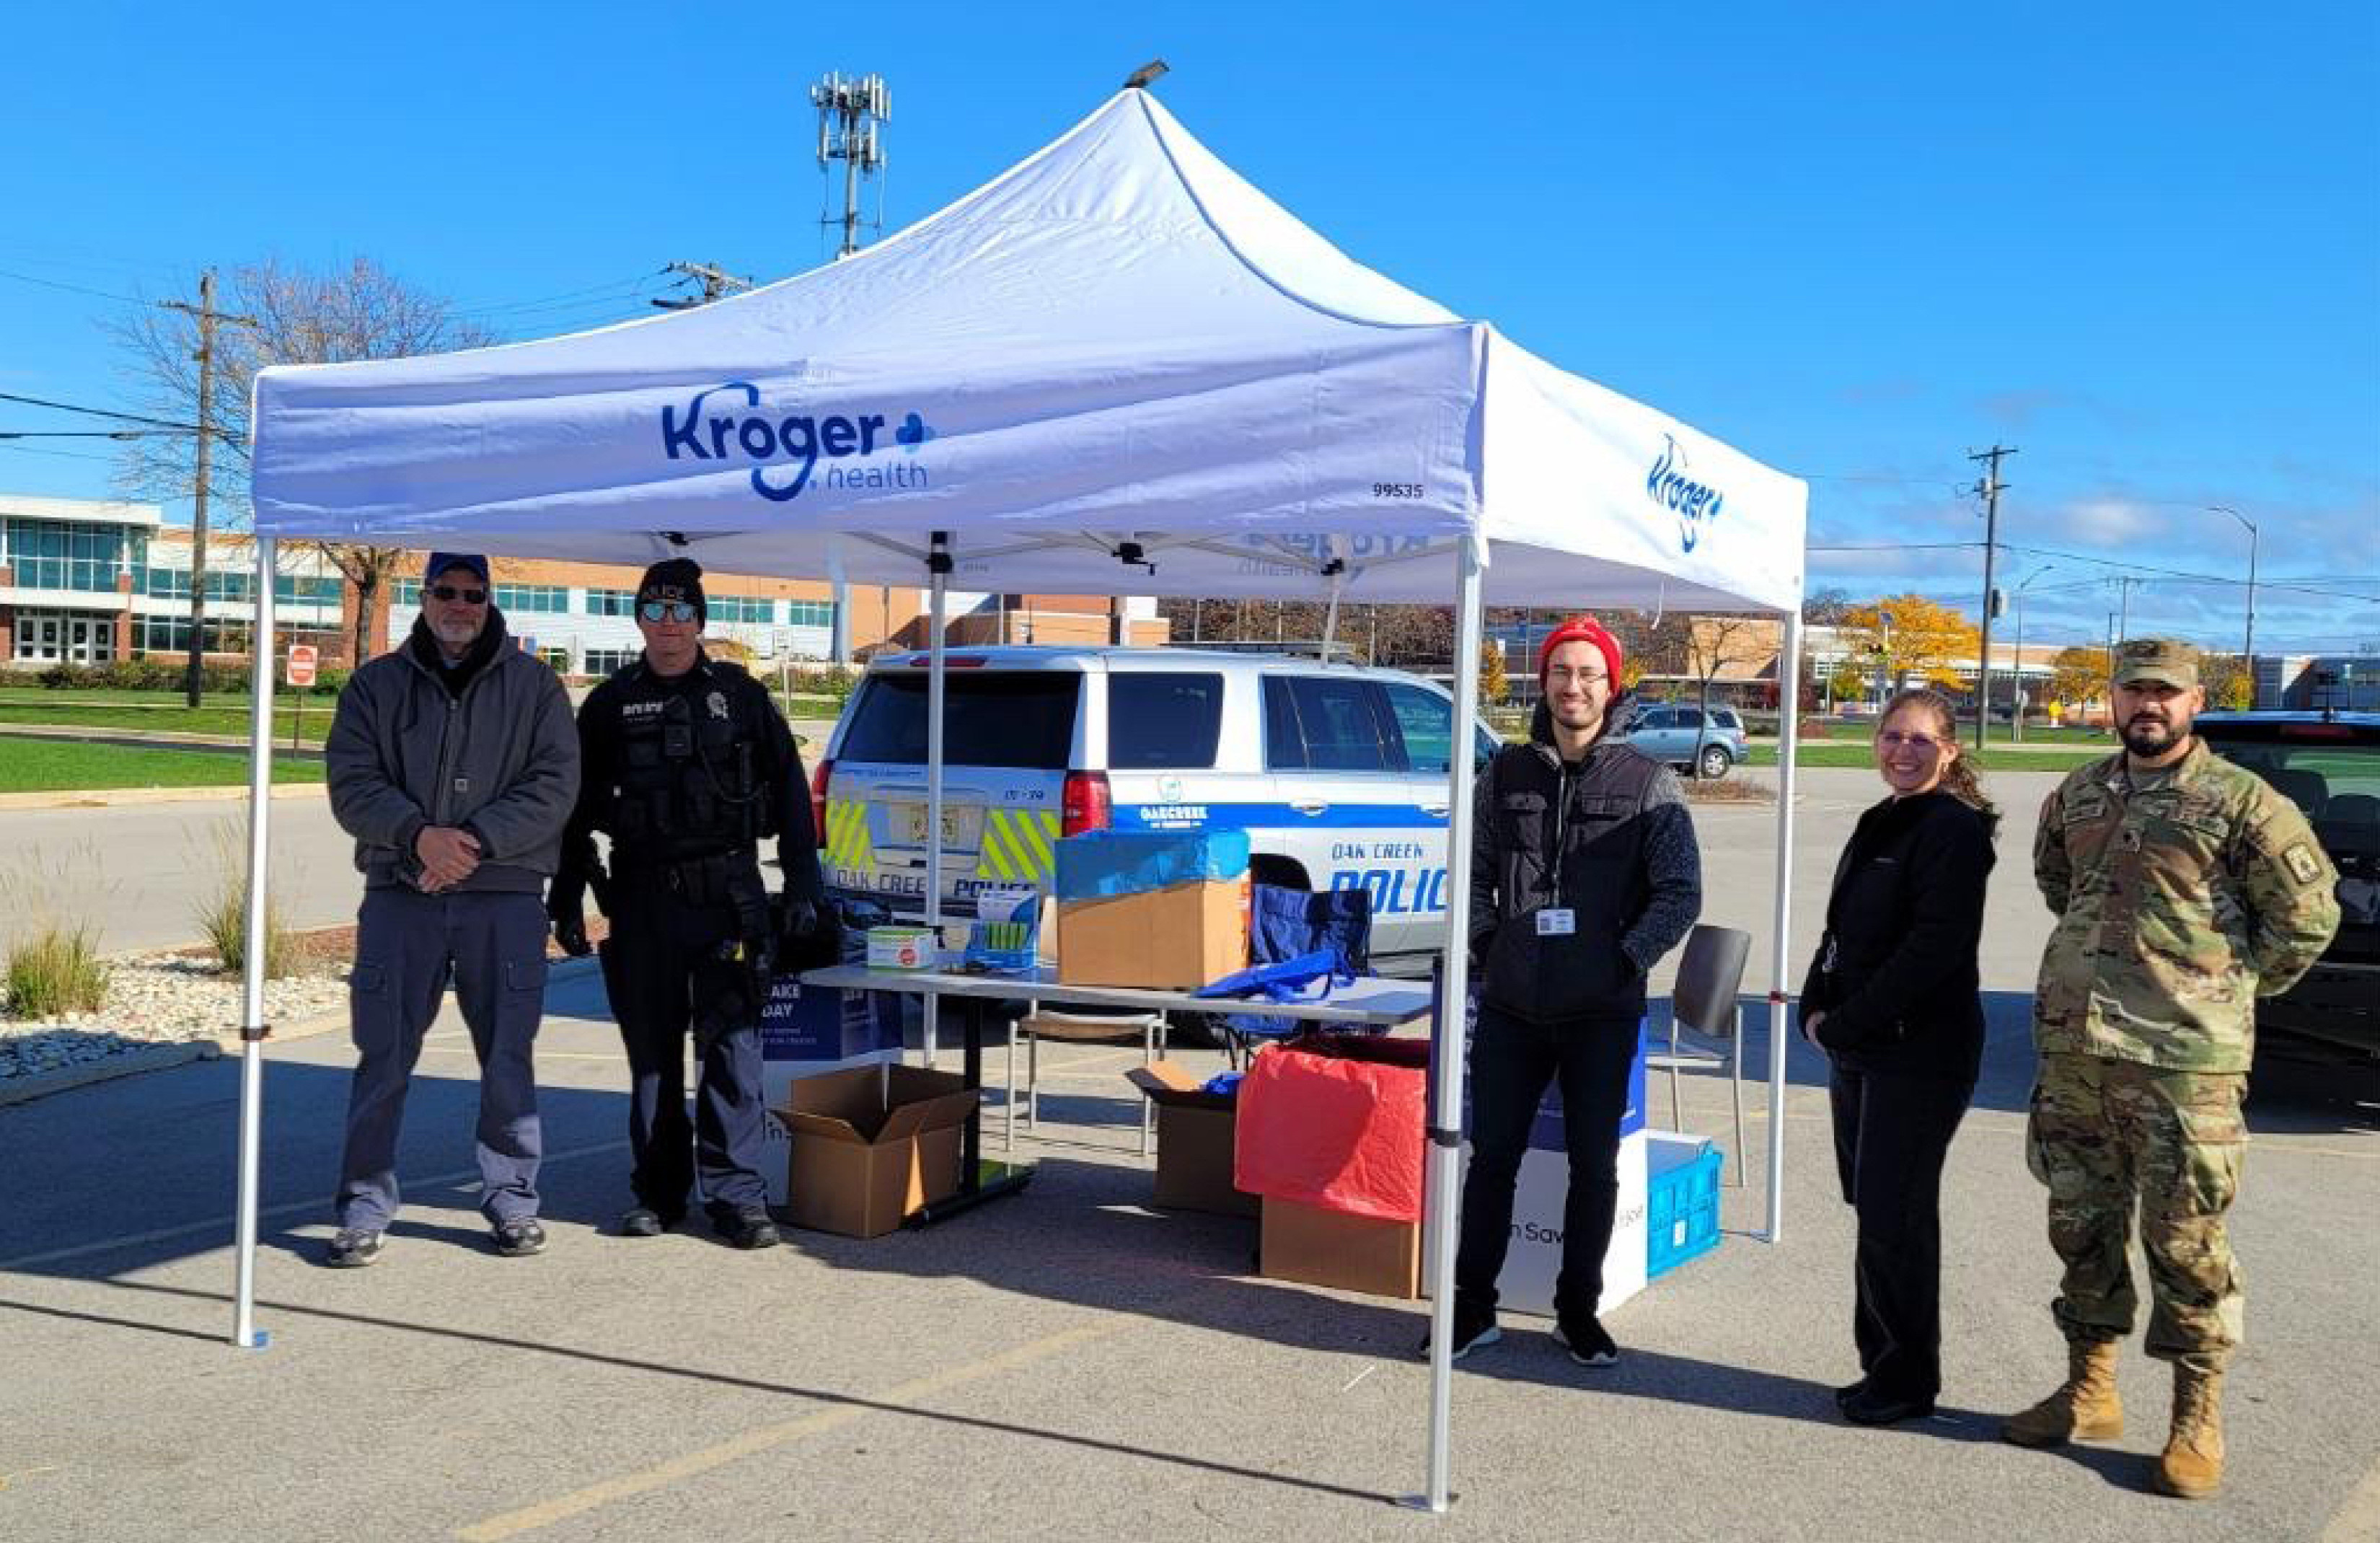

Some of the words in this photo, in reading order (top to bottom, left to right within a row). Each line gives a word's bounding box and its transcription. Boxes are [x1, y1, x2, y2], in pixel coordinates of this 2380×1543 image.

[662, 381, 885, 501] Kroger
[827, 463, 927, 488] health
[1647, 433, 1716, 553] Kroger
[1331, 843, 1365, 860] OAK
[1373, 843, 1424, 859] CREEK
[878, 874, 927, 894] CREE
[1331, 869, 1447, 913] POLIC
[771, 984, 799, 999] AKE
[1525, 1221, 1564, 1244] Sav
